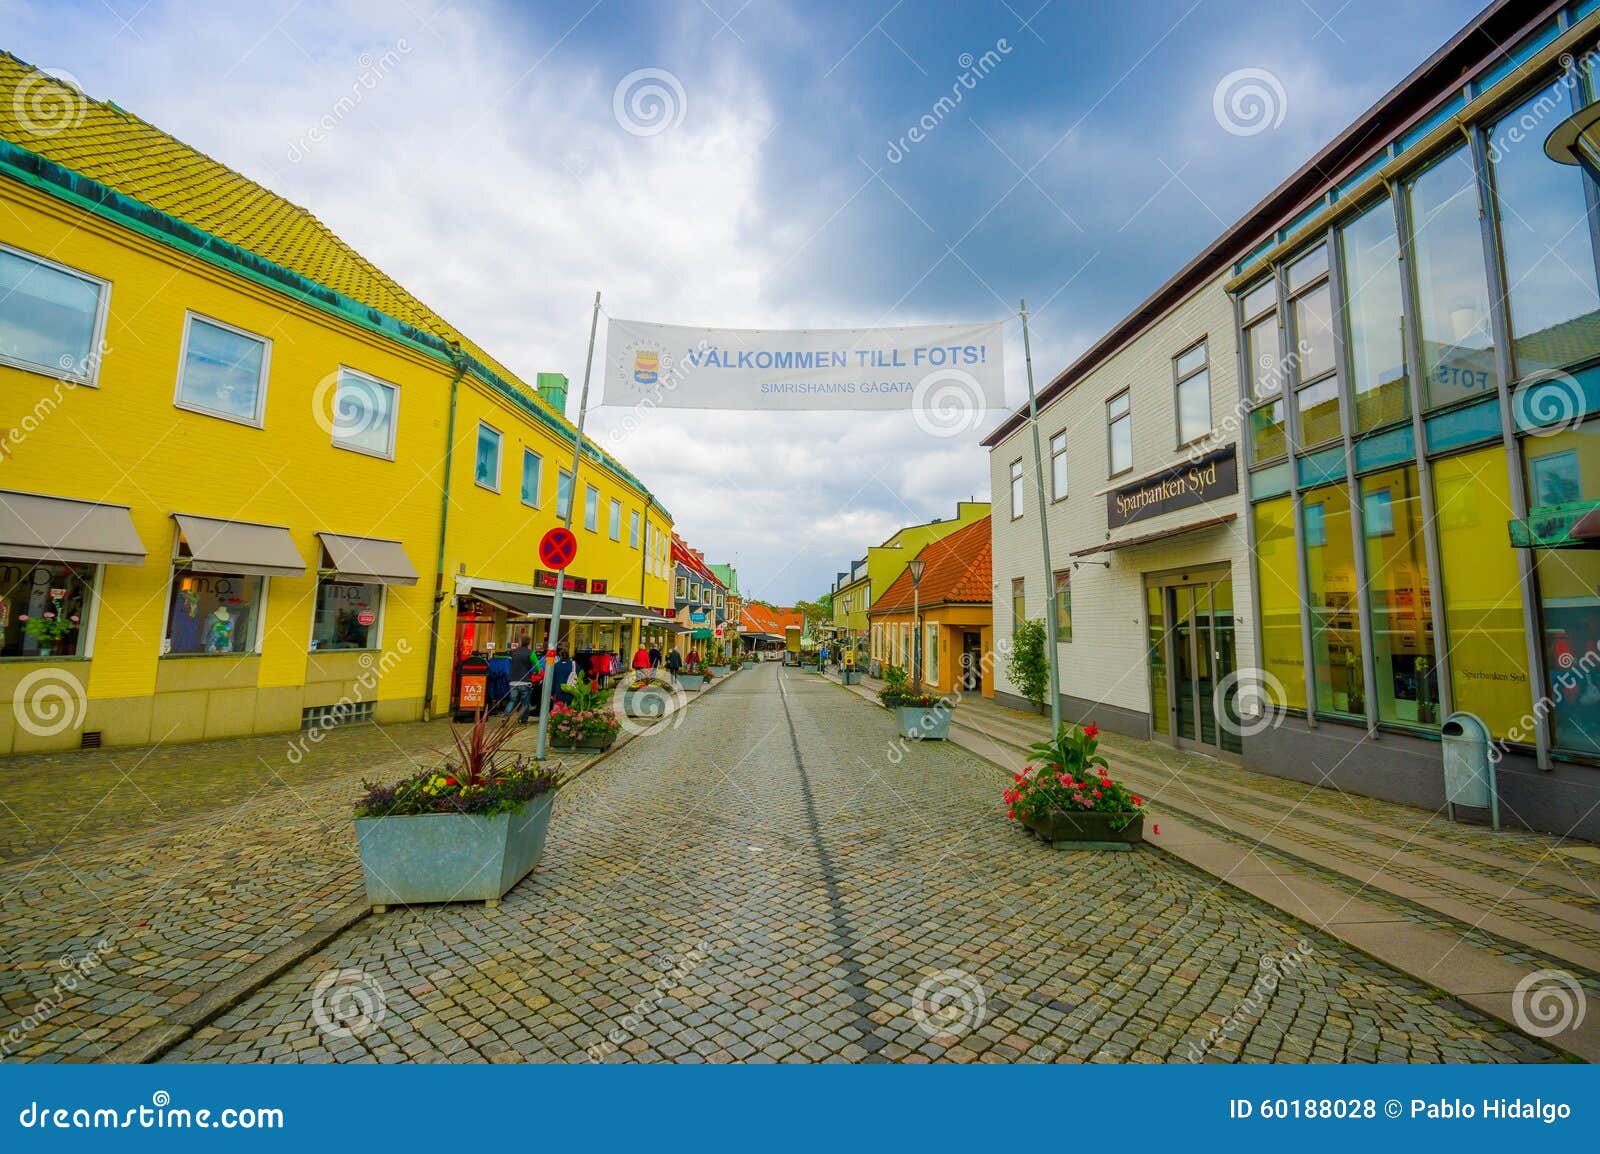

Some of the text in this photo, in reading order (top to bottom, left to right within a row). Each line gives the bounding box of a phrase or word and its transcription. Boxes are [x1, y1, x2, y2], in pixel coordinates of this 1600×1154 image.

[688, 345, 987, 369] VÄLKOMMEN TILL FOTS!
[760, 381, 856, 393] SIMRISHAMNS
[1116, 461, 1216, 517] Sparbanken Syd
